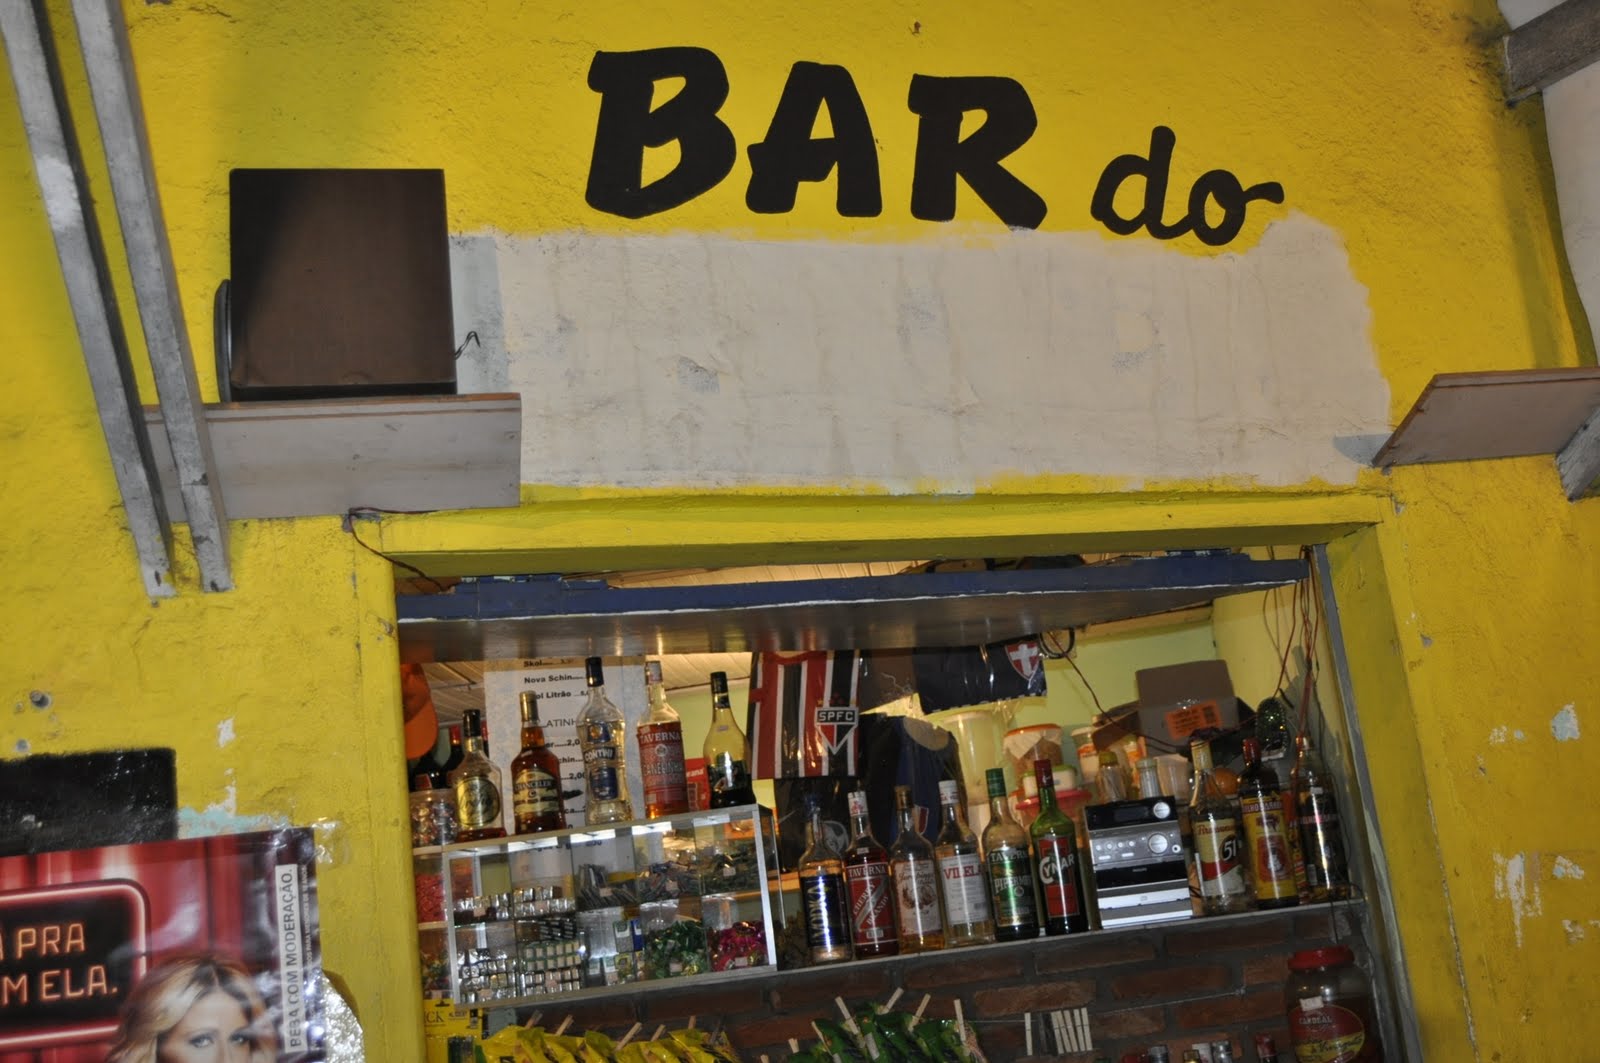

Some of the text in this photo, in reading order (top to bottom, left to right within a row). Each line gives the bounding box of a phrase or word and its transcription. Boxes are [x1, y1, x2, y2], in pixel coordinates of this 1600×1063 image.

[586, 46, 1285, 247] BAR do
[524, 676, 546, 684] Nova
[546, 691, 572, 699] Litrão
[818, 711, 854, 722] SPFC
[639, 729, 681, 744] TAVERNA
[1223, 839, 1237, 861] 51
[848, 865, 887, 878] TAVERNA
[1040, 853, 1075, 884] CYNAR
[280, 868, 298, 967] MODERAÇÃO.
[17, 923, 86, 959] PRA
[42, 965, 118, 1000] ELA.
[286, 970, 300, 1004] COM
